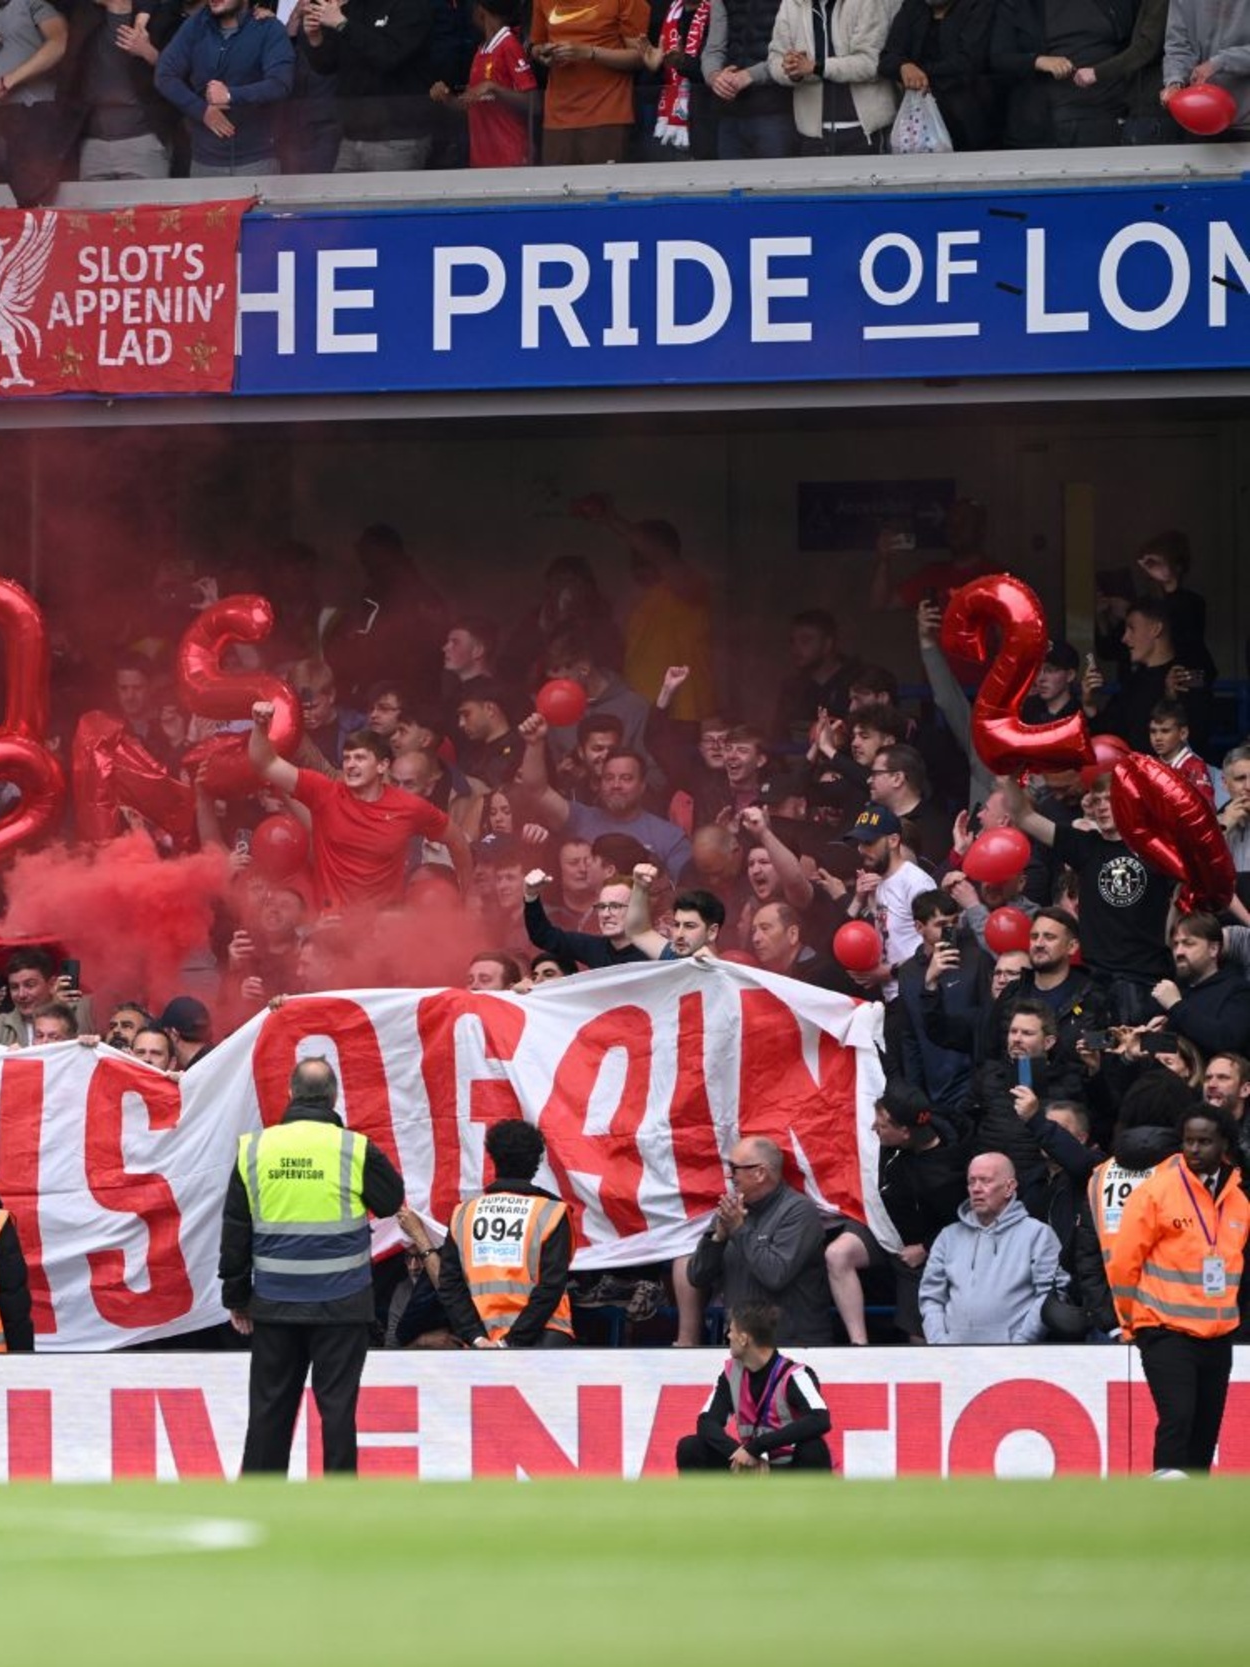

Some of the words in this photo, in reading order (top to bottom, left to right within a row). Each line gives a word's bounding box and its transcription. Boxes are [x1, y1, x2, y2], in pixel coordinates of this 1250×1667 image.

[78, 243, 205, 284] SLOT'S
[47, 283, 225, 330] APPENIN'
[433, 236, 813, 351] PRIDE
[859, 230, 981, 307] OF
[97, 328, 173, 367] LAD
[268, 1169, 324, 1180] SUPERVISOR
[280, 1157, 312, 1168] SENIOR
[477, 1206, 529, 1215] STEWARD
[473, 1217, 525, 1242] 094
